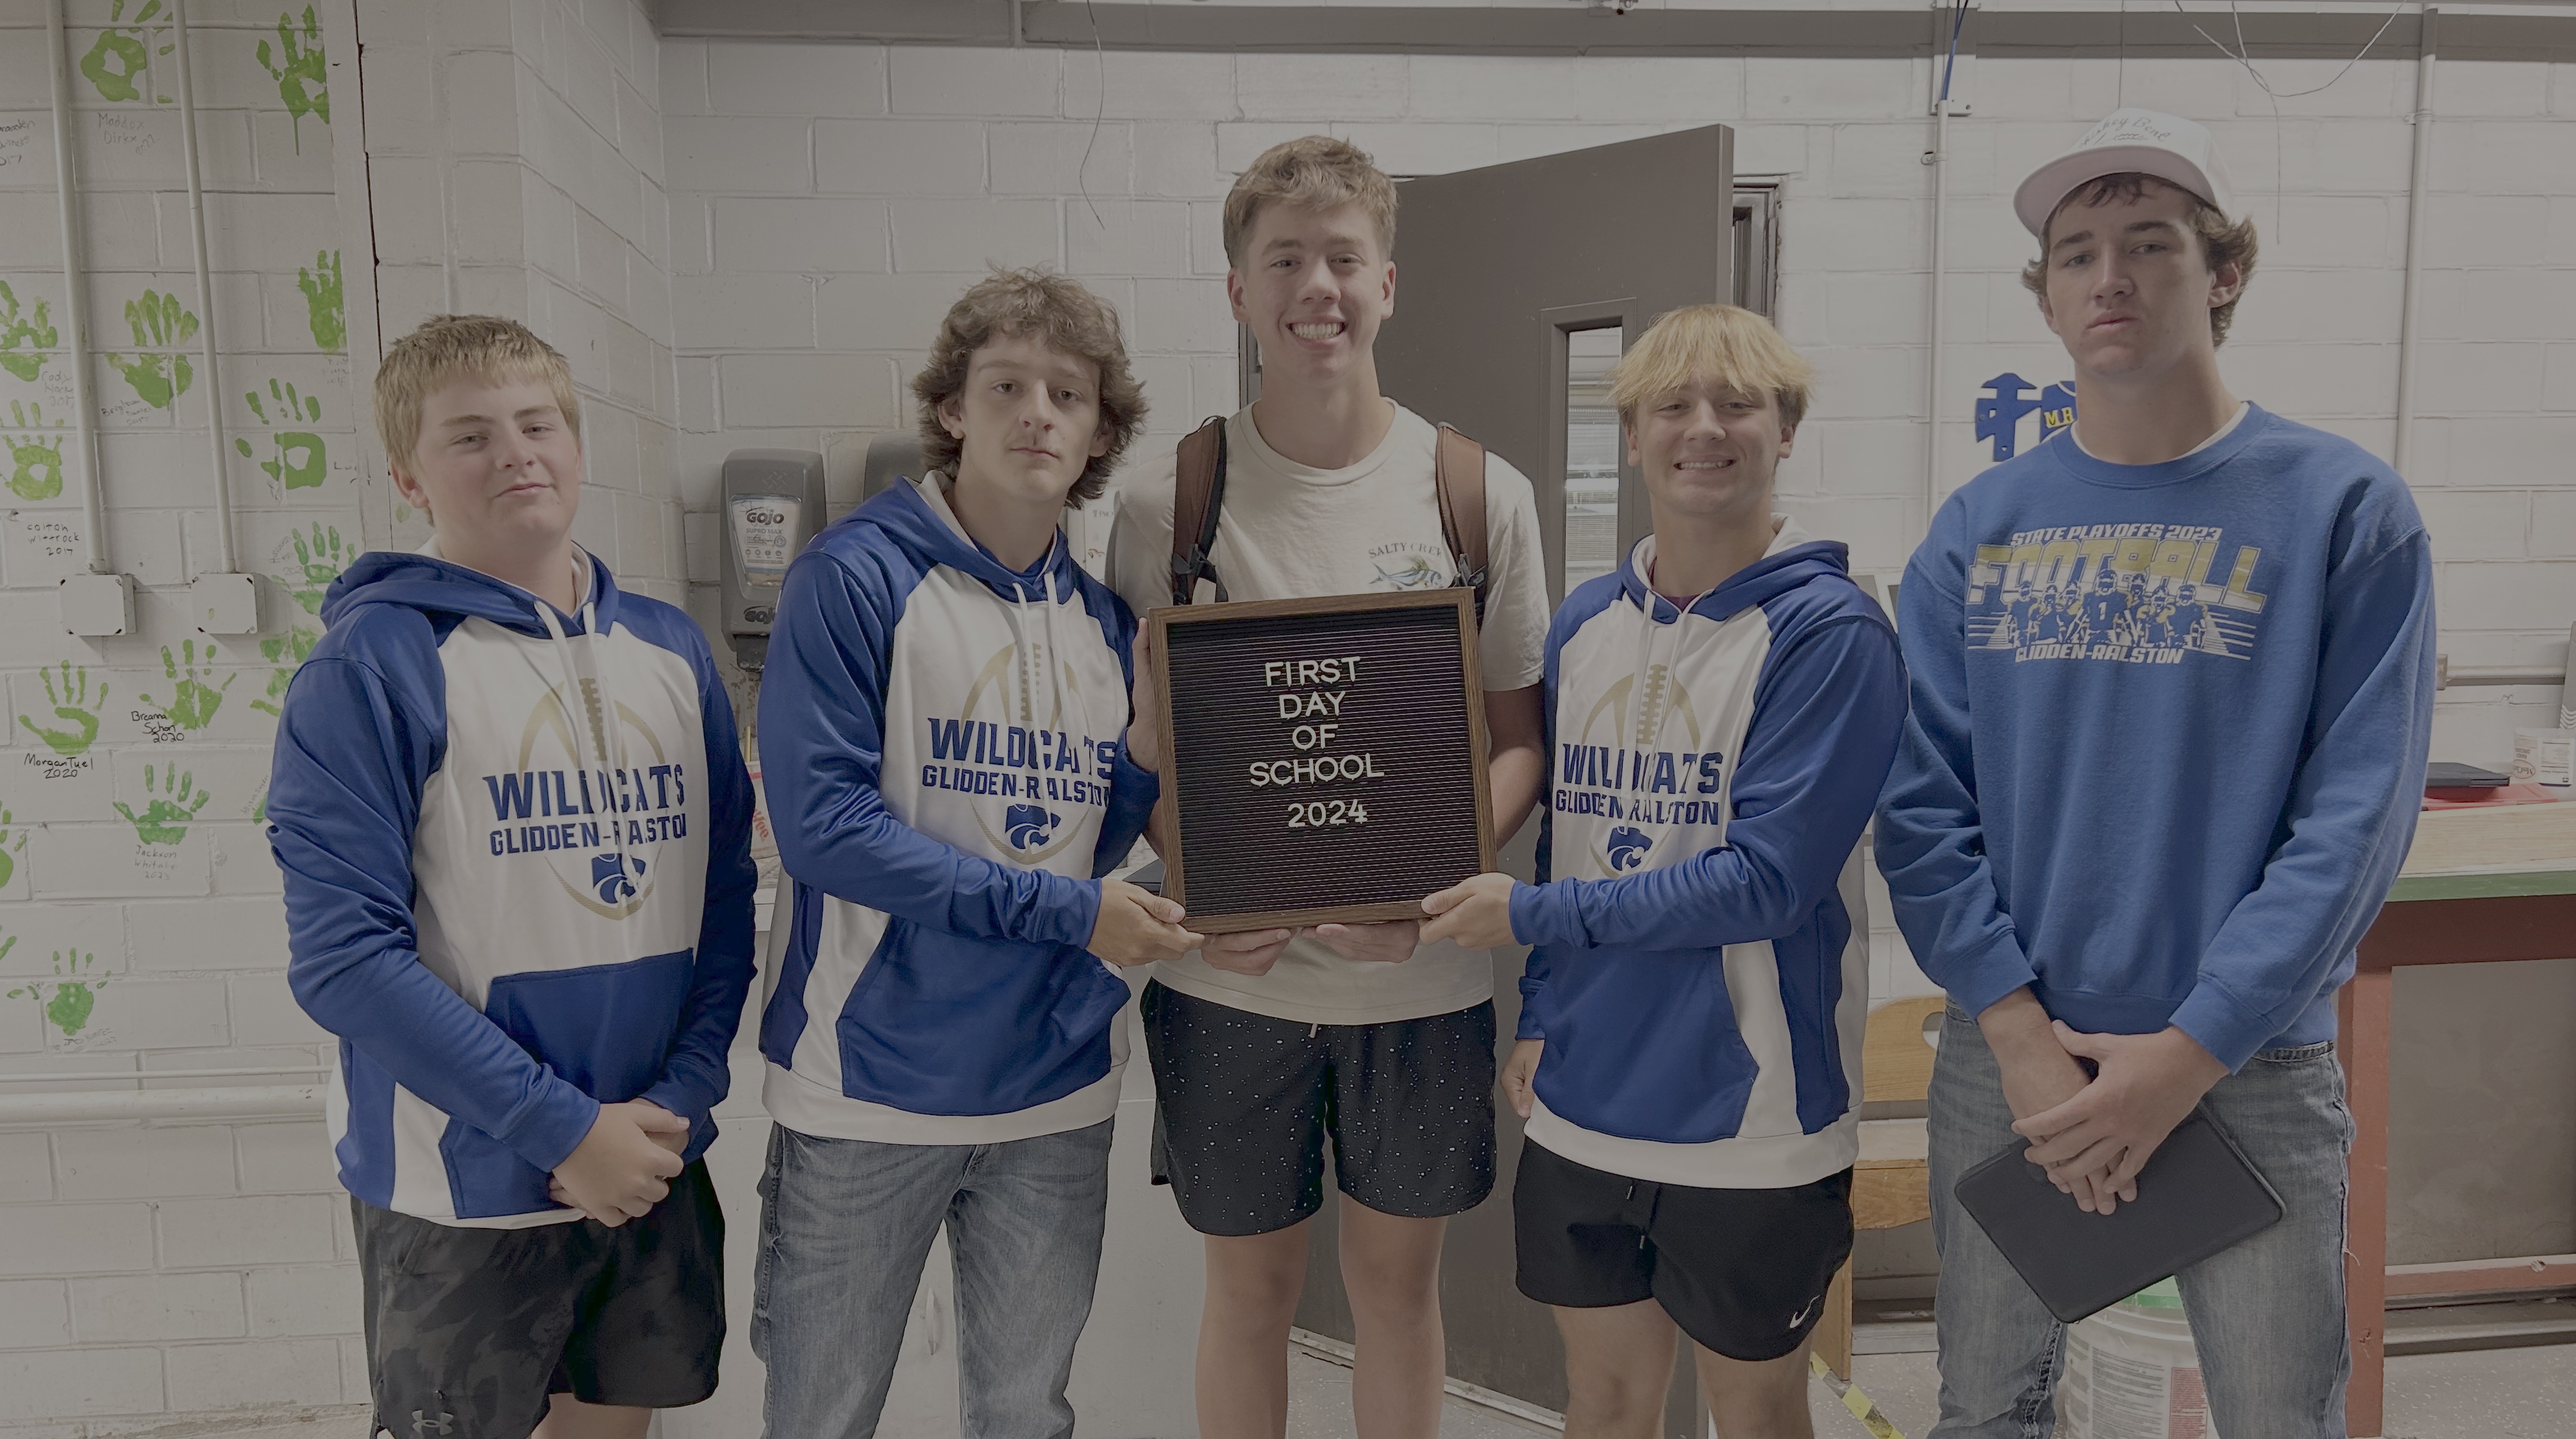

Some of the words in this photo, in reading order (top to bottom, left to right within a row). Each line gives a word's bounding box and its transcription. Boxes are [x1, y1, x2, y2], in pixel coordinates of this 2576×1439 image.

[0, 155, 22, 165] 017
[2011, 527, 2066, 546] STATE
[2066, 523, 2164, 539] PLAYOFFS
[2164, 525, 2223, 541] 2023
[46, 546, 73, 556] 2017
[1368, 542, 1407, 559] SALTY
[1966, 536, 2267, 614] FOOTBALL
[2015, 643, 2184, 664] GLIDDEN-RALSTON
[1265, 656, 1360, 687] FIRST
[1279, 691, 1346, 719] DAY
[151, 732, 185, 743] 2020
[927, 717, 1117, 780] WILDCATS
[1292, 724, 1338, 750] OF
[43, 768, 78, 779] 2020
[1250, 752, 1385, 787] SCHOOL
[1287, 799, 1367, 827] 2024
[489, 812, 687, 857] GLIDDEN-RASTO
[136, 845, 177, 858] Jackson
